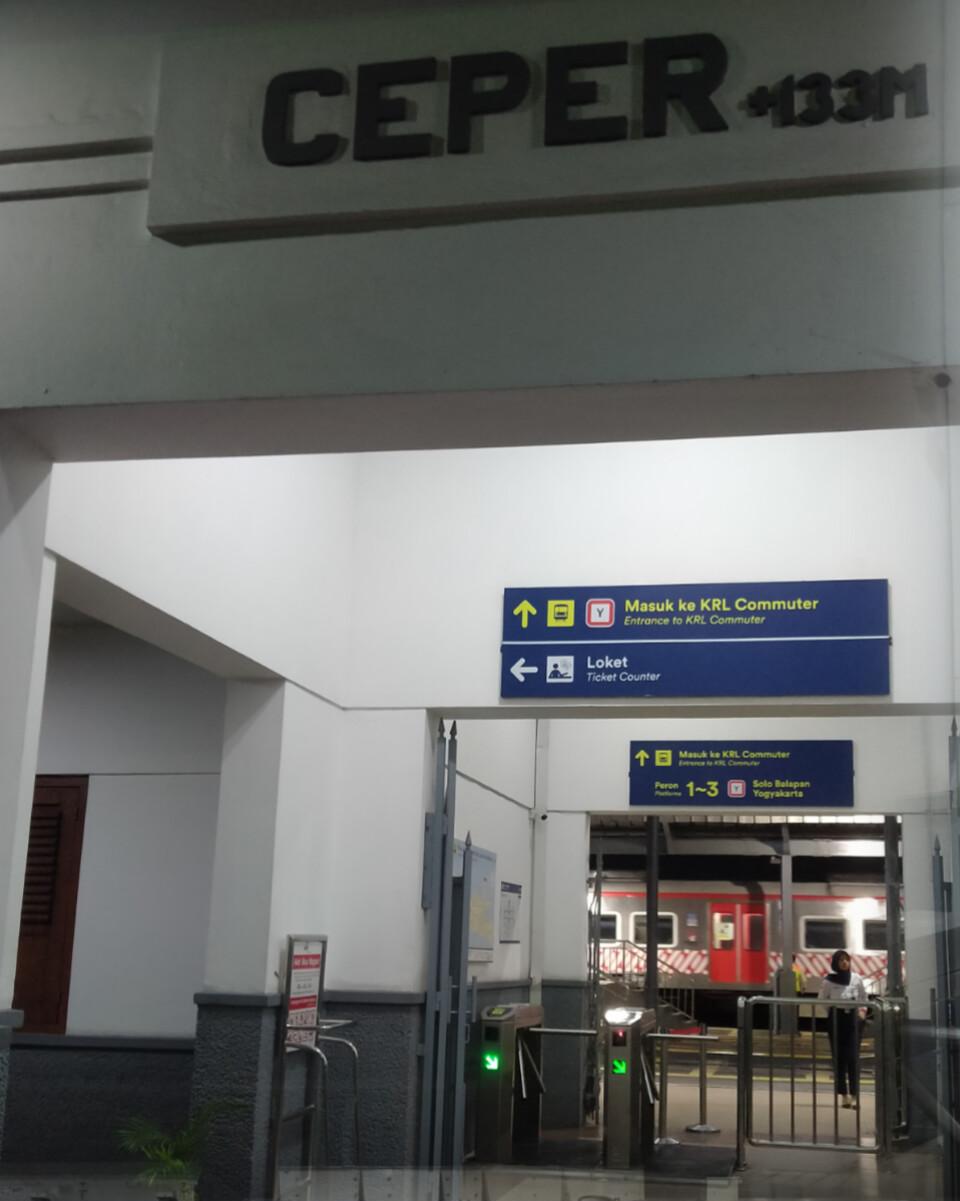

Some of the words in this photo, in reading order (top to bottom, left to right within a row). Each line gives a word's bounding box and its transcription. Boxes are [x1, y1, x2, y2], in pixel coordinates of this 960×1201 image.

[261, 32, 729, 167] CEPER
[625, 600, 673, 612] Masuk
[679, 600, 695, 611] ke
[701, 599, 730, 611] KRL
[735, 598, 818, 611] Commuter
[597, 607, 604, 617] Y
[624, 616, 669, 625] Entrance
[686, 615, 705, 624] KRL
[710, 615, 765, 624] Commuter
[588, 656, 627, 668] Loket
[588, 672, 617, 681] Ticket
[620, 671, 660, 681] Counter
[687, 781, 718, 797] 1~3
[775, 780, 810, 788] Balapan
[753, 790, 803, 799] Yogyakarta
